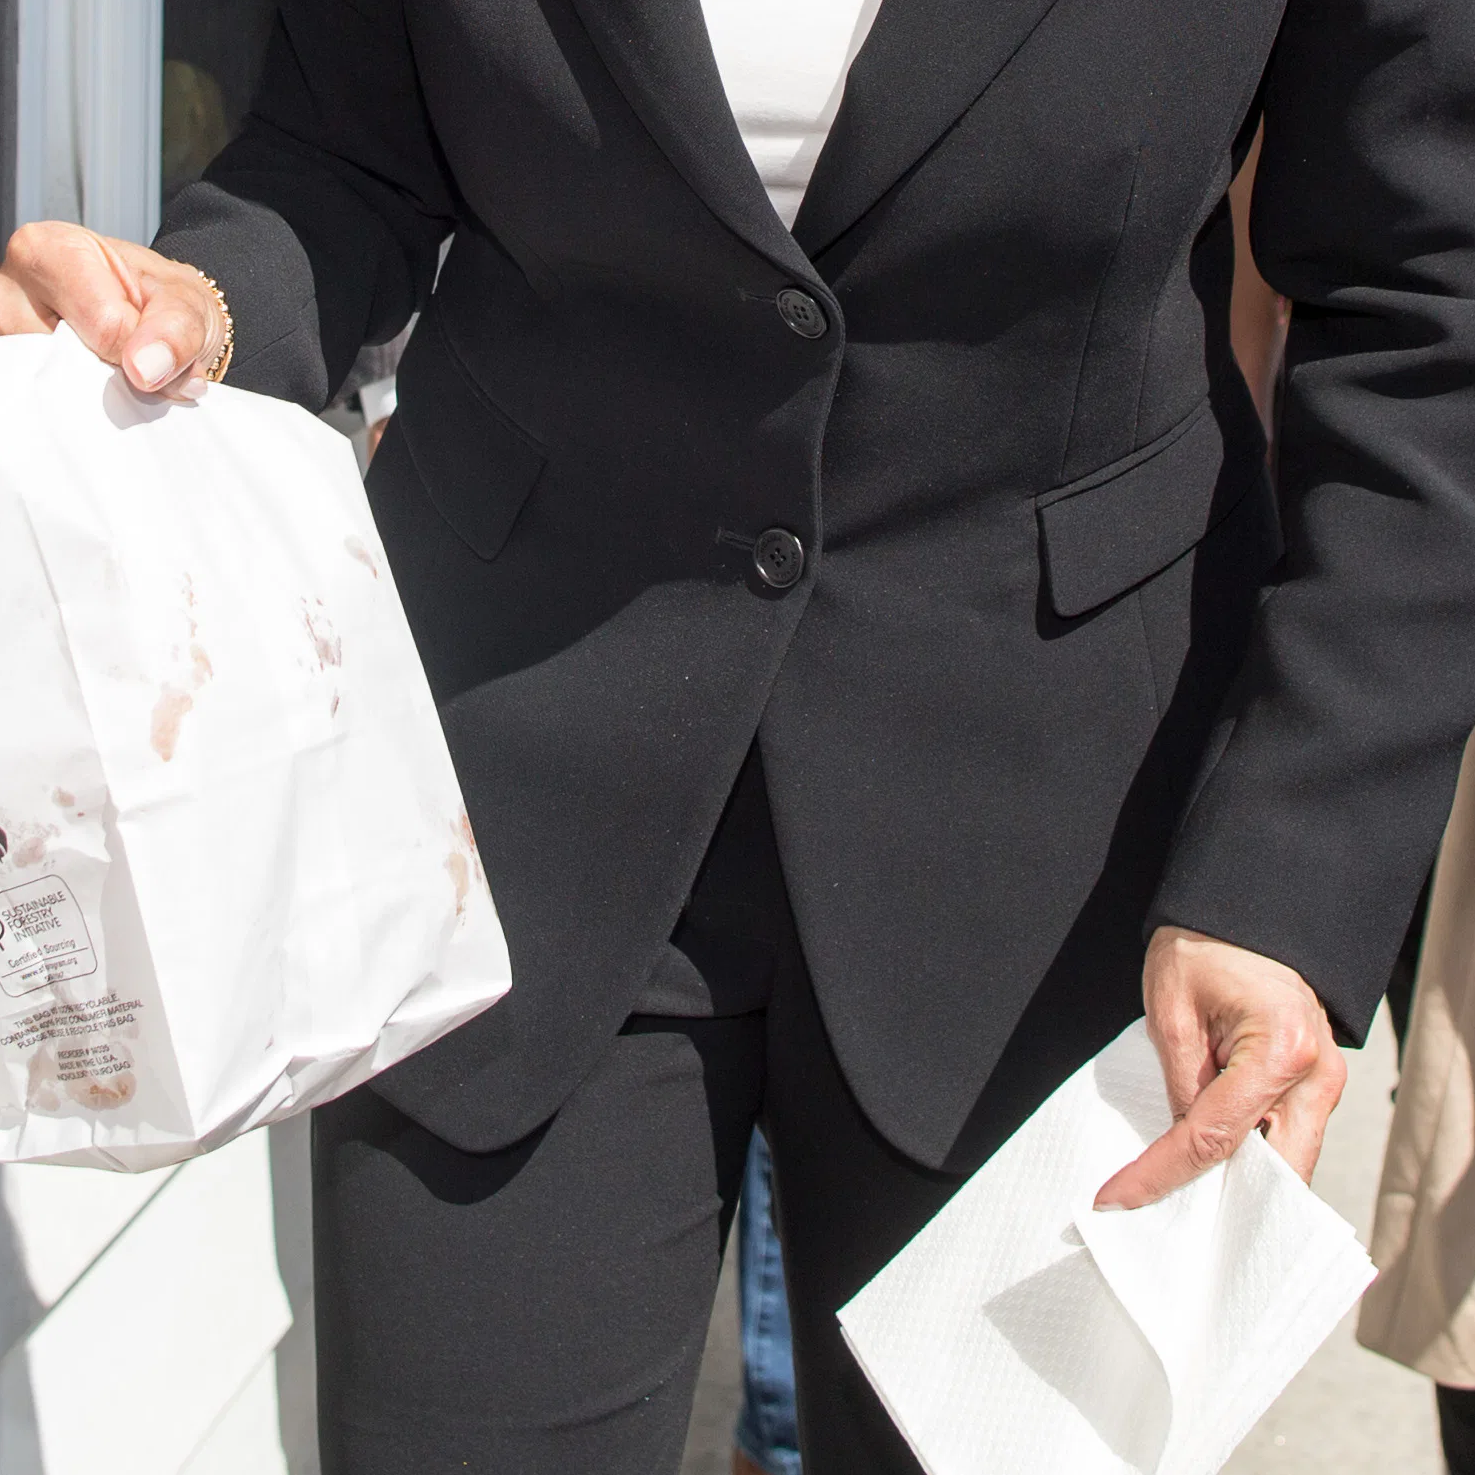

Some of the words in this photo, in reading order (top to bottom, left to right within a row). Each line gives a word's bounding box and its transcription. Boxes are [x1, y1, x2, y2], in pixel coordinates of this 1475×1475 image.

[2, 891, 66, 921] SUSTAINABLE
[7, 907, 54, 931] FORESTRY
[13, 917, 62, 942] INITIATIVE
[8, 947, 43, 968] Certified
[43, 939, 76, 954] Sourcing
[0, 1025, 39, 1045] CONTAINS
[68, 1008, 107, 1025] CONSUMER
[107, 999, 144, 1015] MATERIAL
[33, 1010, 51, 1021] BAG
[17, 1031, 47, 1049] PLEASE
[113, 1061, 131, 1072] BAG
